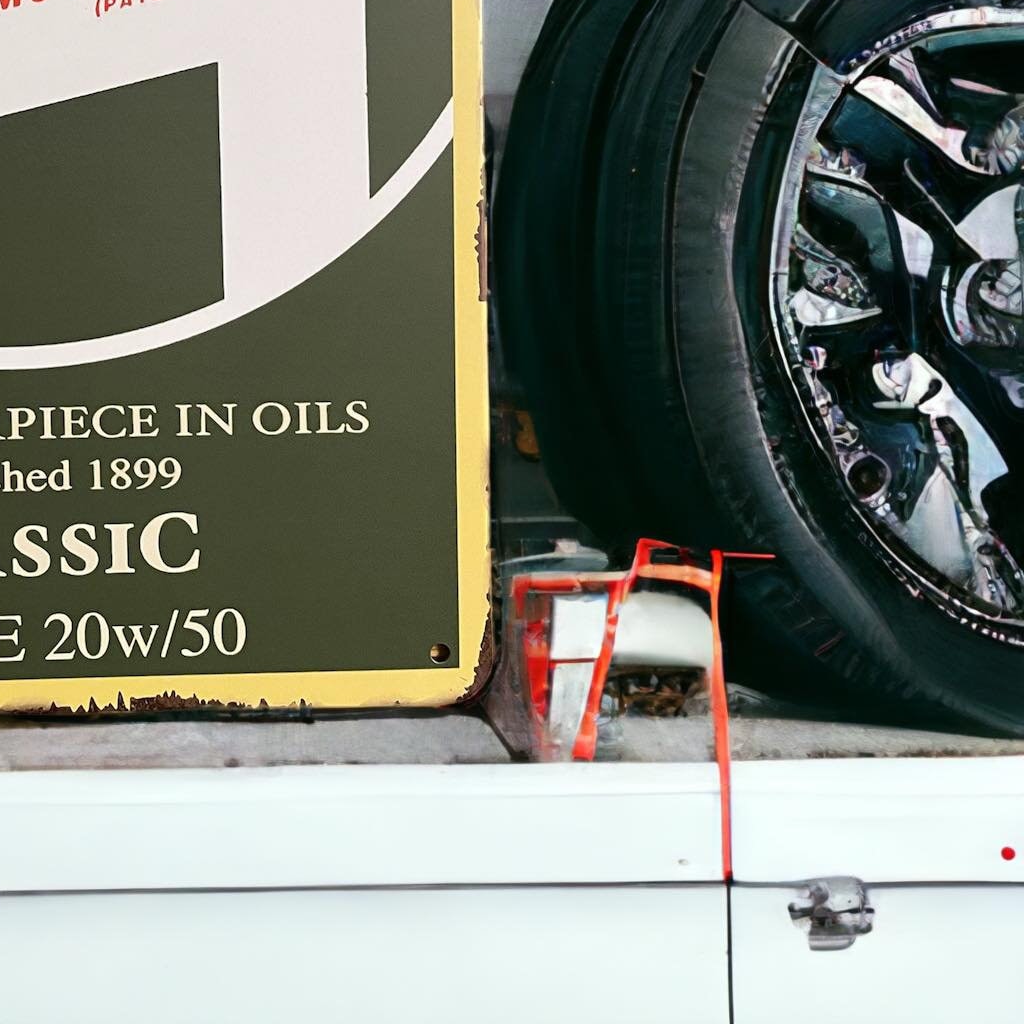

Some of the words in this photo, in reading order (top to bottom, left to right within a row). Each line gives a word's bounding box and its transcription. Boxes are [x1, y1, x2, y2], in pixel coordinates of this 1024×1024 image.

[174, 403, 238, 437] IN
[252, 400, 370, 436] OILS
[88, 456, 182, 491] 1899
[43, 608, 247, 661] 20w/50
